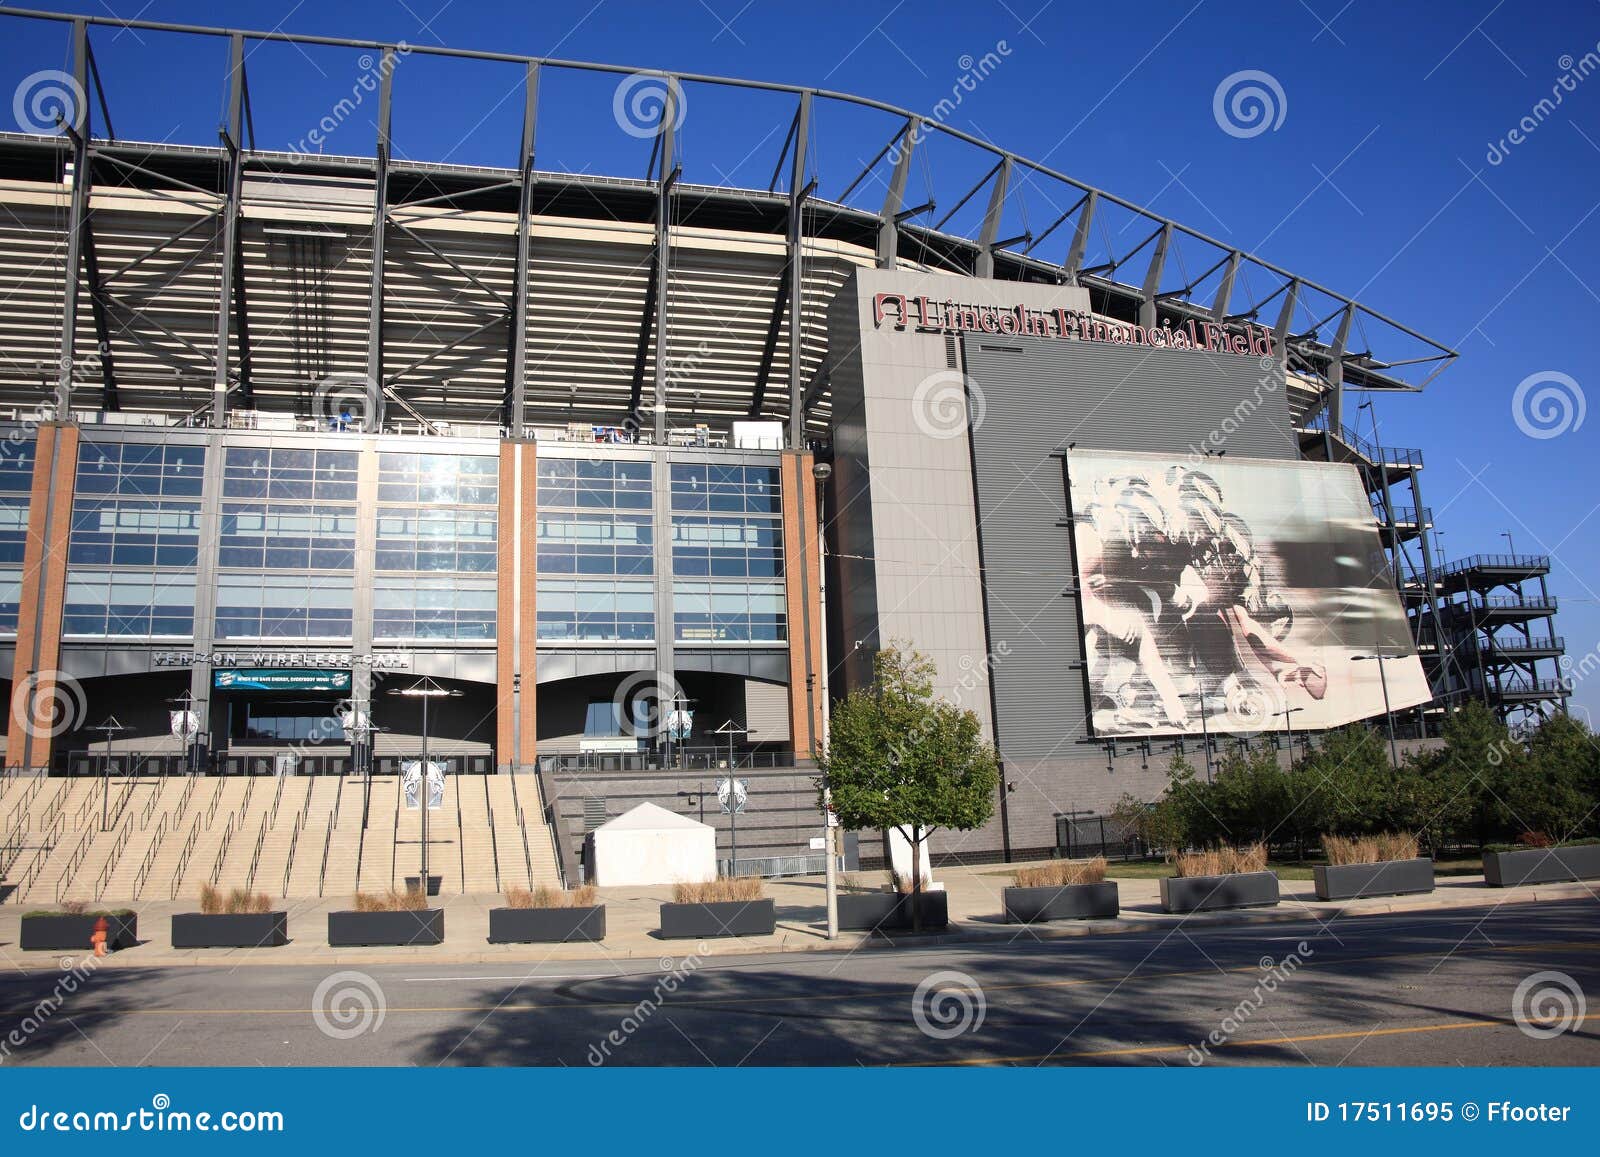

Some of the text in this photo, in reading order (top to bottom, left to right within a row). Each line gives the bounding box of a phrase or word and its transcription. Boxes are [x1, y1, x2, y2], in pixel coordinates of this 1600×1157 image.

[916, 295, 1273, 357] Lincoln Financial Field
[153, 653, 237, 663] VERIZON
[251, 653, 350, 664] WIRELESS
